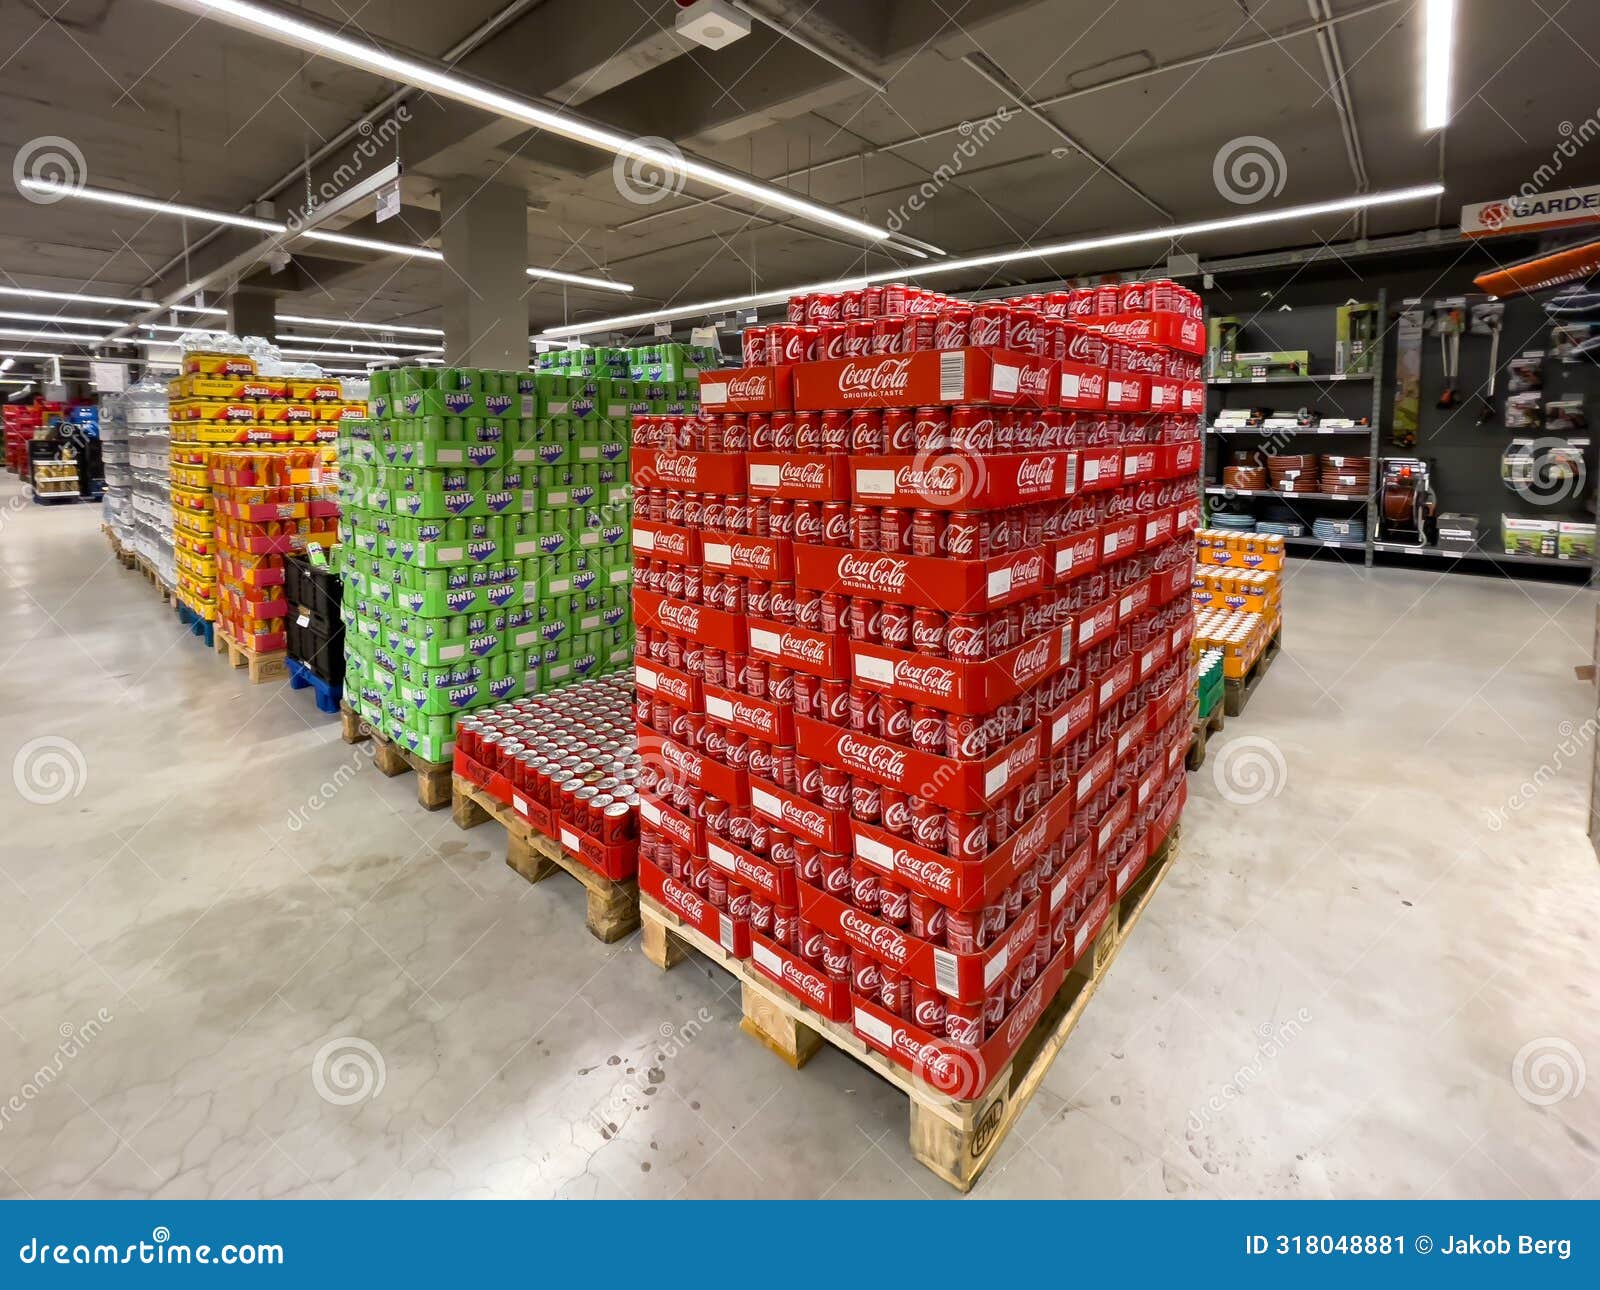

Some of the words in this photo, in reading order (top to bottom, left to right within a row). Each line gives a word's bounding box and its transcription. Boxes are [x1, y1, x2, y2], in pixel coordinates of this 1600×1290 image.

[839, 358, 912, 391] Coca-Cola
[727, 375, 766, 397] Coca-Cola
[843, 390, 878, 398] ORIGINAL
[445, 393, 474, 404] FANTA
[486, 396, 512, 406] FANTA
[572, 400, 593, 409] FANTA
[468, 446, 496, 457] FANTA
[539, 445, 563, 455] FANTA
[602, 443, 623, 453] FANTA
[656, 454, 697, 478] Coca-Cola
[781, 462, 826, 484] Coca-Cola
[1017, 457, 1056, 487] Coca-Cola
[896, 465, 956, 490] Coca-Cola
[445, 492, 474, 505] FANTA
[486, 492, 513, 504] FANTA
[572, 486, 593, 498] FANTA
[540, 534, 564, 547] FANTA
[603, 525, 624, 539] FANTA
[654, 530, 685, 551] Coca-Cola
[468, 541, 496, 553] FANTA
[731, 543, 772, 565] Coca-Cola
[573, 570, 595, 584] FANTA
[838, 553, 909, 587] Coca-Cola
[447, 591, 477, 605] FANTA
[488, 586, 515, 598] FANTA
[843, 580, 876, 591] ORIGINAL
[879, 585, 901, 594] TASTE
[603, 607, 624, 621] FANTA
[658, 599, 700, 630] Coca-Cola
[542, 620, 566, 635] FANTA
[470, 635, 498, 649] FANTA
[781, 633, 826, 660] Coca-Cola
[574, 654, 596, 669] FANTA
[1013, 637, 1051, 679] Coca-Cola
[489, 677, 515, 691] FANTA
[656, 672, 688, 697] Coca-Cola
[894, 660, 955, 691] Coca-Cola
[449, 685, 478, 699] FANTA
[899, 681, 927, 692] ORIGINAL
[929, 689, 949, 697] TASTE
[733, 702, 773, 728] Coca-Cola
[837, 734, 908, 775] Coca-Cola
[842, 758, 876, 774] ORIGINAL
[878, 771, 901, 782] TASTE
[661, 811, 692, 840] Coca-Cola
[781, 800, 826, 833] Coca-Cola
[735, 855, 774, 887] Coca-Cola
[894, 849, 955, 888] Coca-Cola
[899, 869, 927, 884] ORIGINAL
[928, 880, 949, 893] TASTE
[662, 878, 704, 919] Coca-Cola
[840, 909, 908, 959] Coca-Cola
[844, 930, 877, 955] ORIGINAL
[883, 949, 904, 964] TASTE
[782, 960, 828, 999] Coca-Cola
[893, 1029, 952, 1073] Coca-Cola
